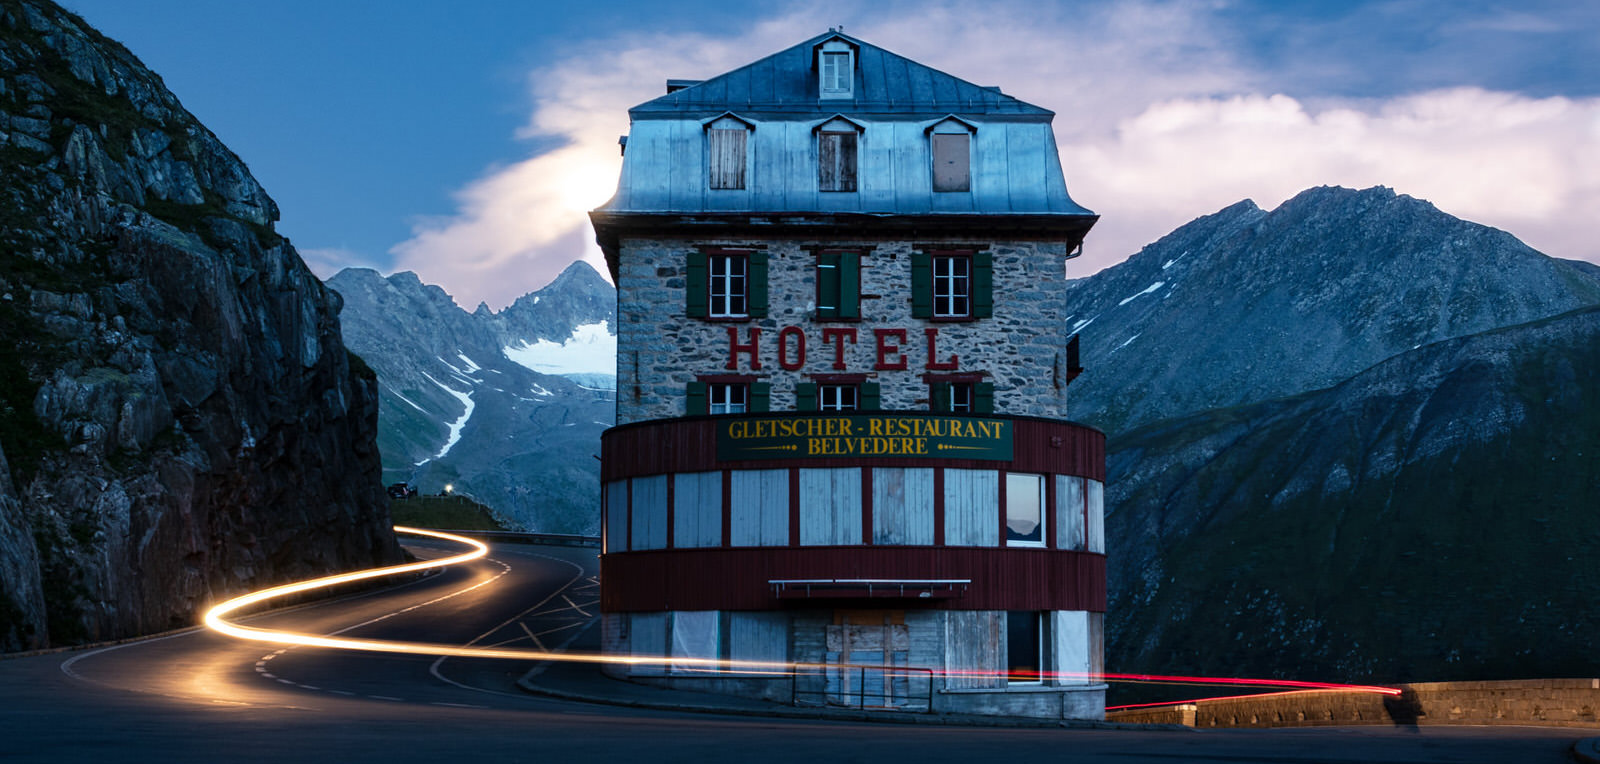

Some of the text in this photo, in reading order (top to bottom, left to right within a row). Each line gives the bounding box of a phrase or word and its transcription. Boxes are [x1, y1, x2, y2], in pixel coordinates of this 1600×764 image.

[726, 325, 959, 371] HOTEL
[728, 418, 853, 439] GLETSCHER
[869, 418, 1004, 440] RESTAURANT
[807, 437, 929, 455] BELVEDERE
